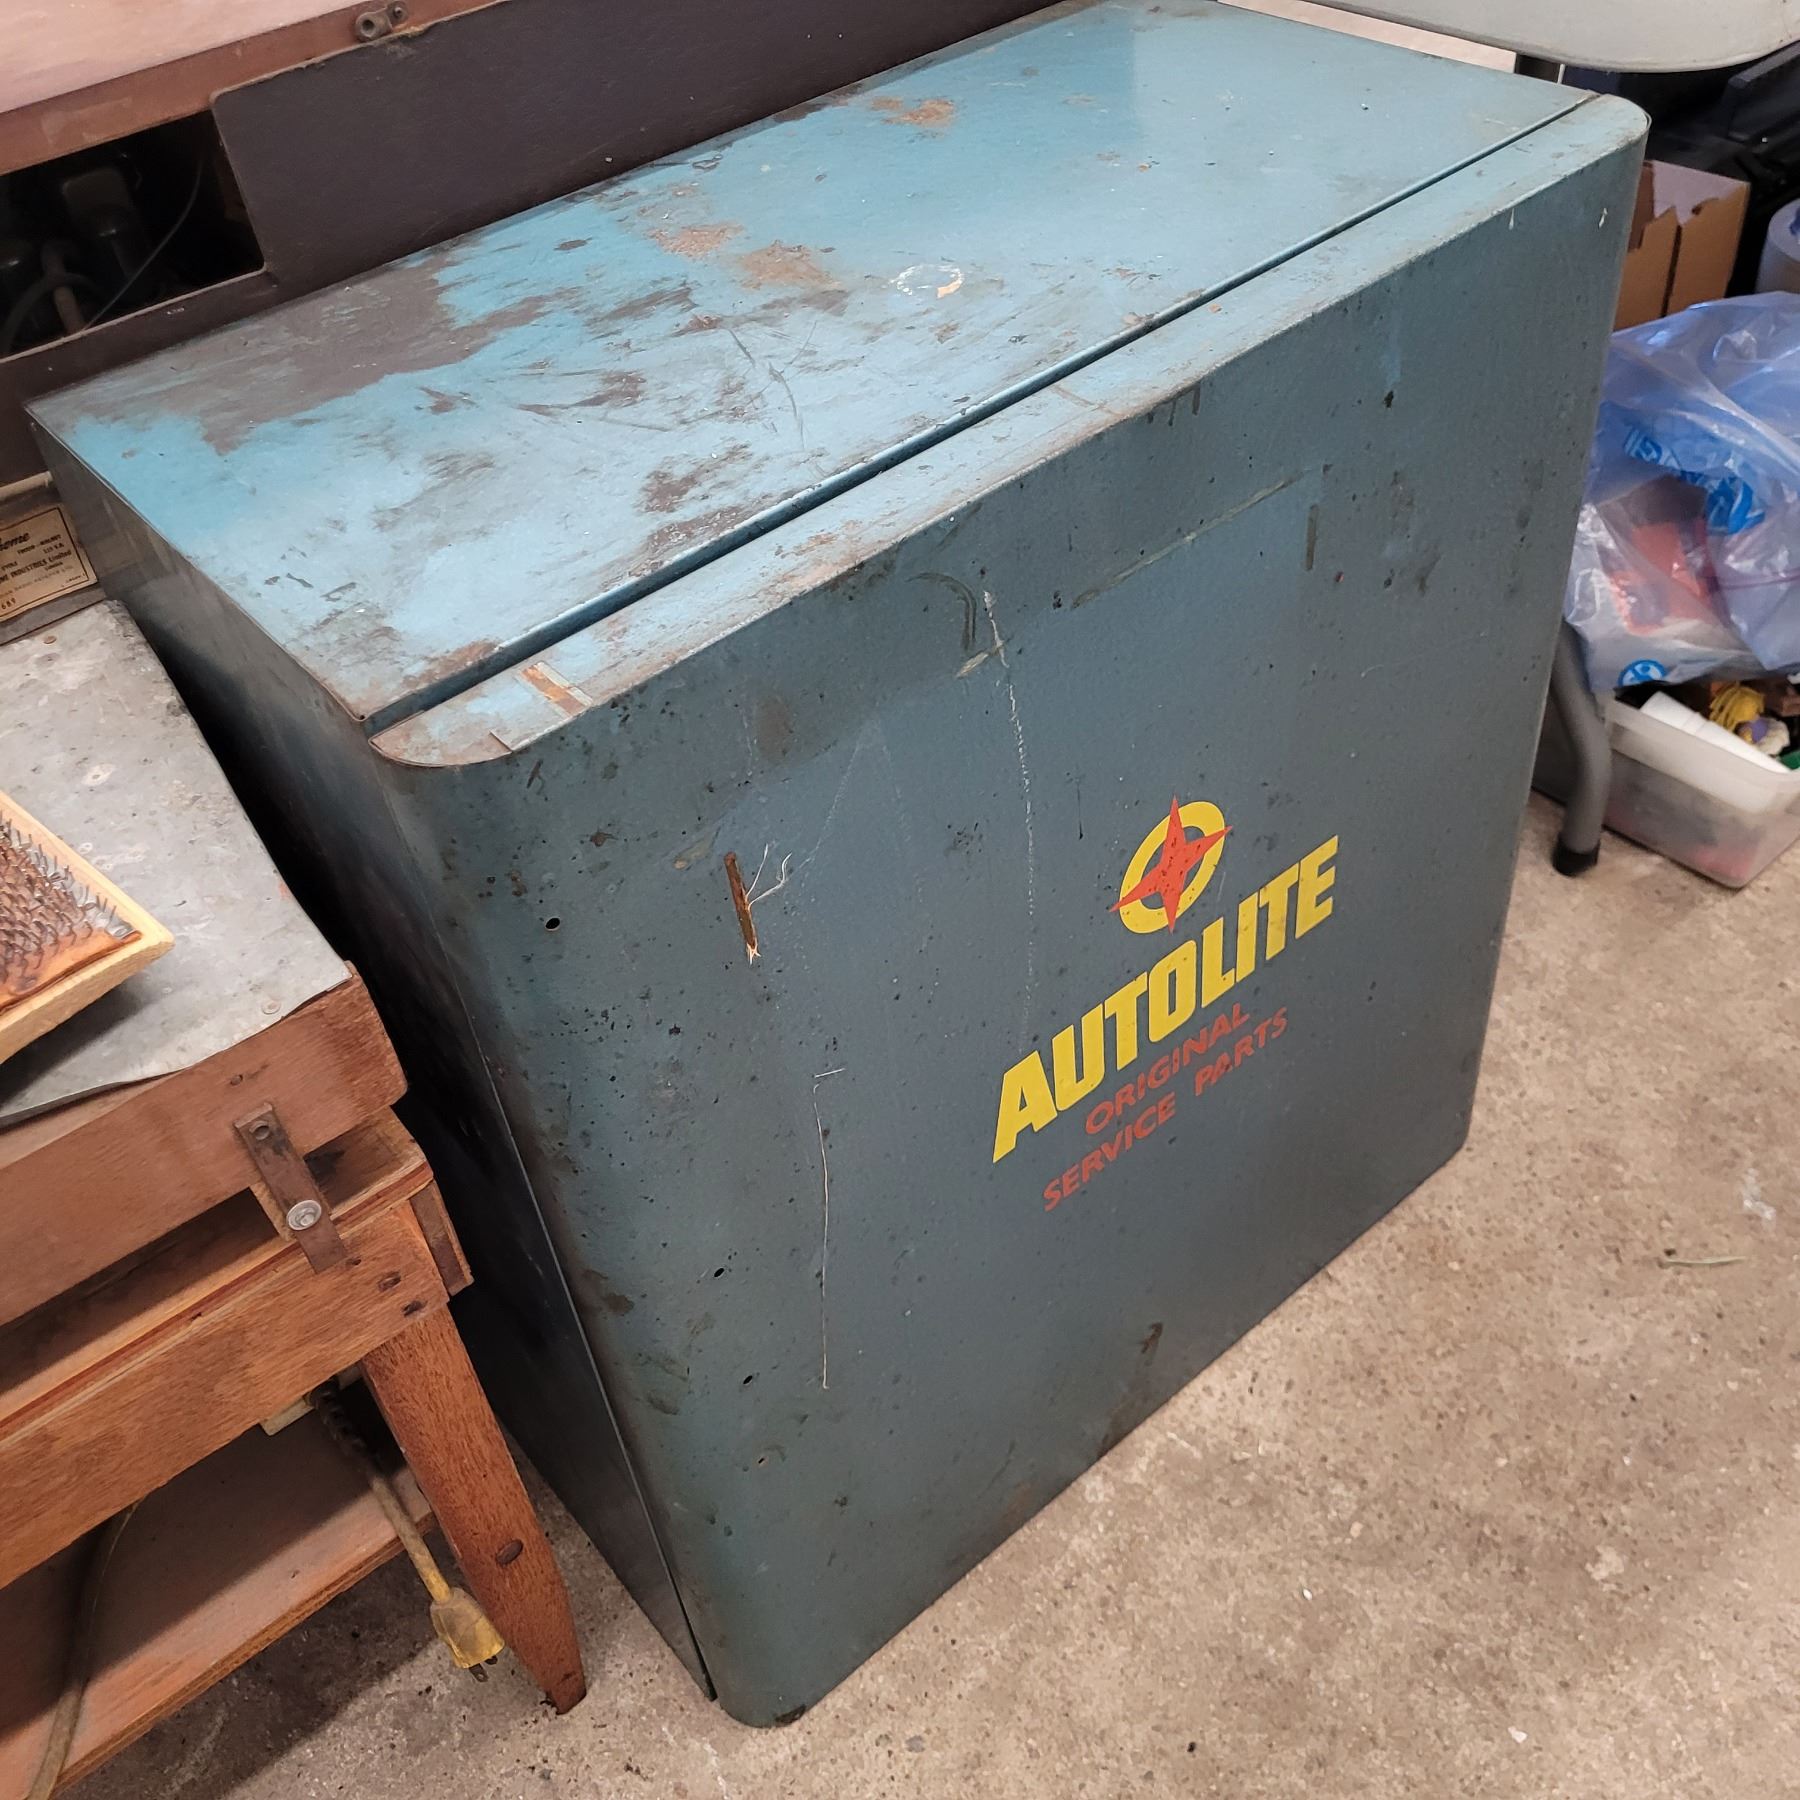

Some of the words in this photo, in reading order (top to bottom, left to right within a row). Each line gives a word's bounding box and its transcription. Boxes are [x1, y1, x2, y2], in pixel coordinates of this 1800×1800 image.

[993, 835, 1339, 1163] AUTOLITE
[1085, 1002, 1250, 1136] ORIGINAL
[1043, 1091, 1177, 1212] SERVICE
[1194, 1007, 1288, 1096] PARTS
